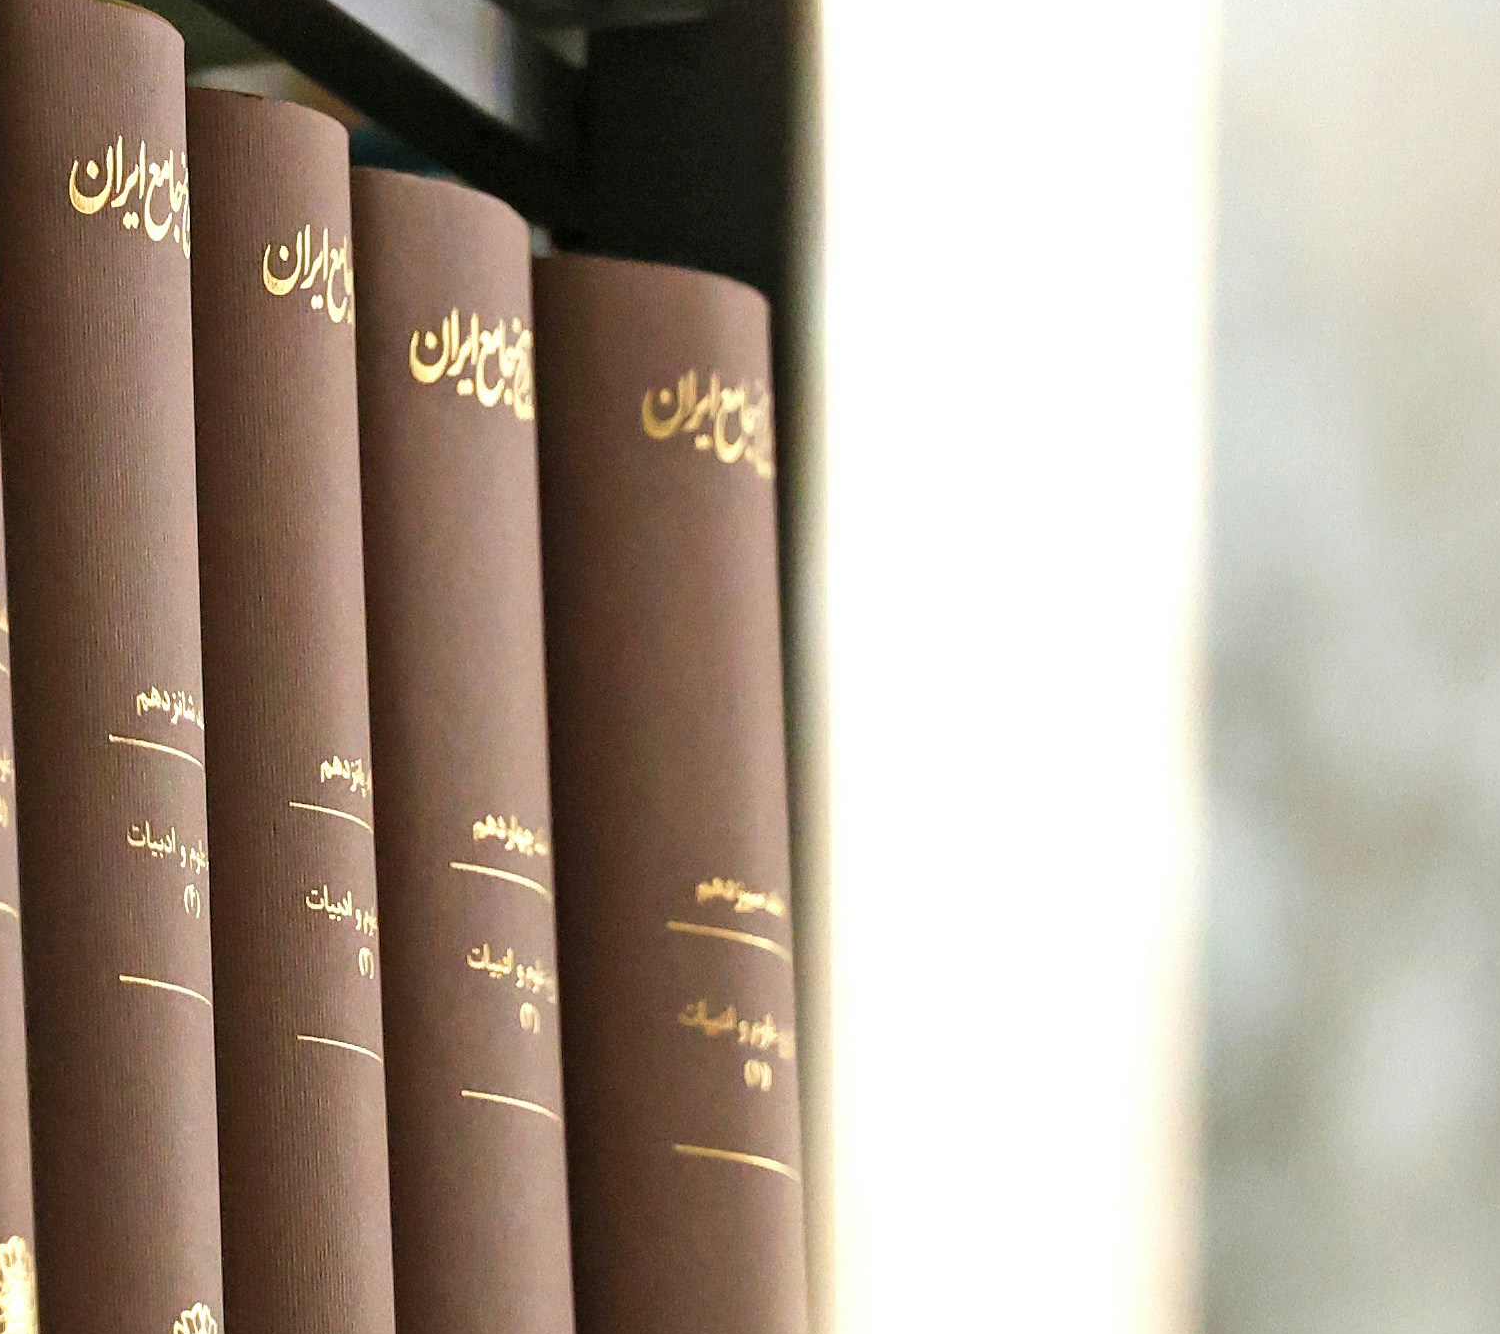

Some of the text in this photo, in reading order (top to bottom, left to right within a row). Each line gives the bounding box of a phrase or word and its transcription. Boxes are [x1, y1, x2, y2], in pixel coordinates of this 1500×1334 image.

[69, 134, 146, 230] ایران
[262, 223, 329, 310] ایران
[408, 305, 480, 397] ایران
[641, 368, 721, 452] ایران
[136, 685, 196, 725] شانزدهم
[126, 820, 176, 859] ادبیات
[305, 884, 353, 922] ادبیات
